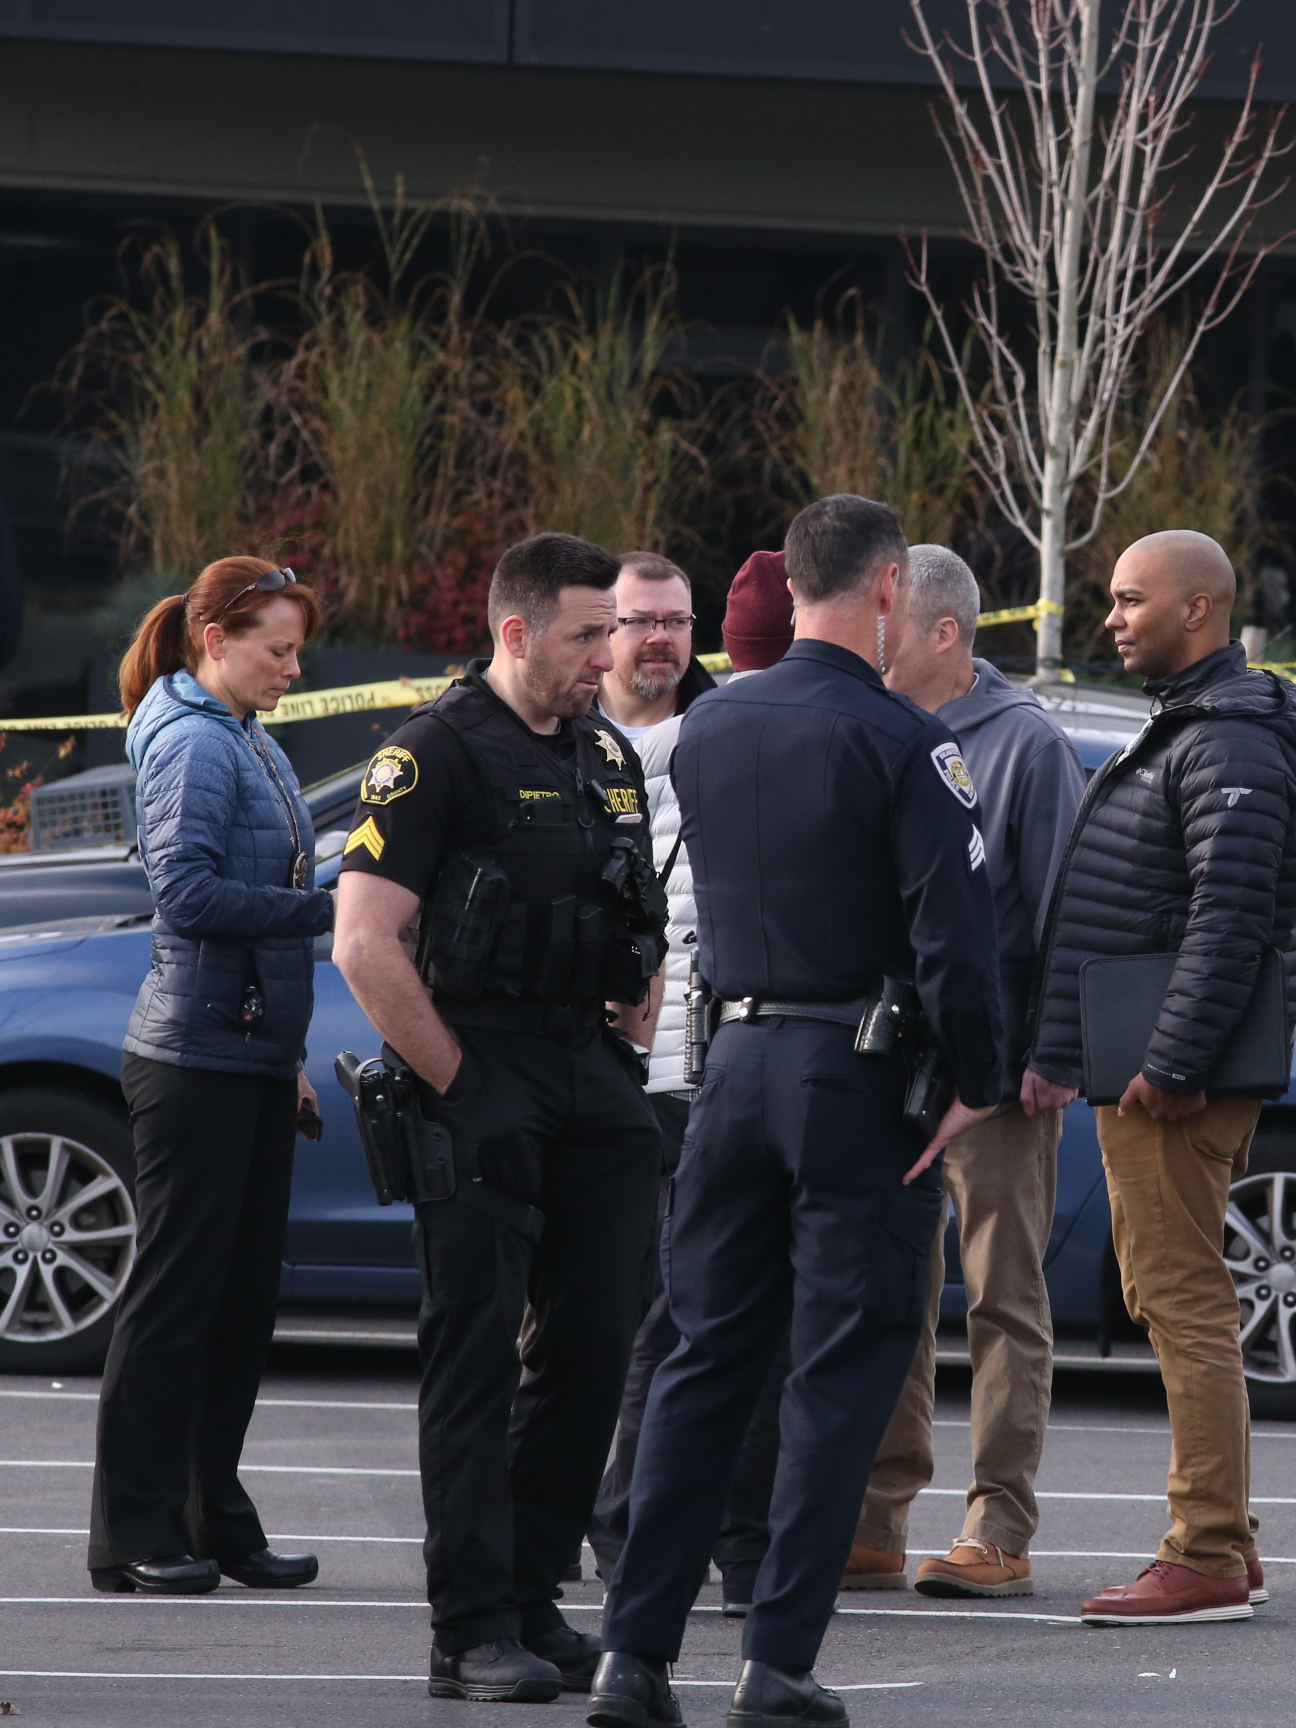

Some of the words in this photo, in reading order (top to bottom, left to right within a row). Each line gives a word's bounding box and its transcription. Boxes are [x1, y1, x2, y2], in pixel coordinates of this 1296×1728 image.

[280, 698, 316, 717] LINE
[321, 689, 376, 713] POLICE
[377, 748, 411, 762] SHERIFF
